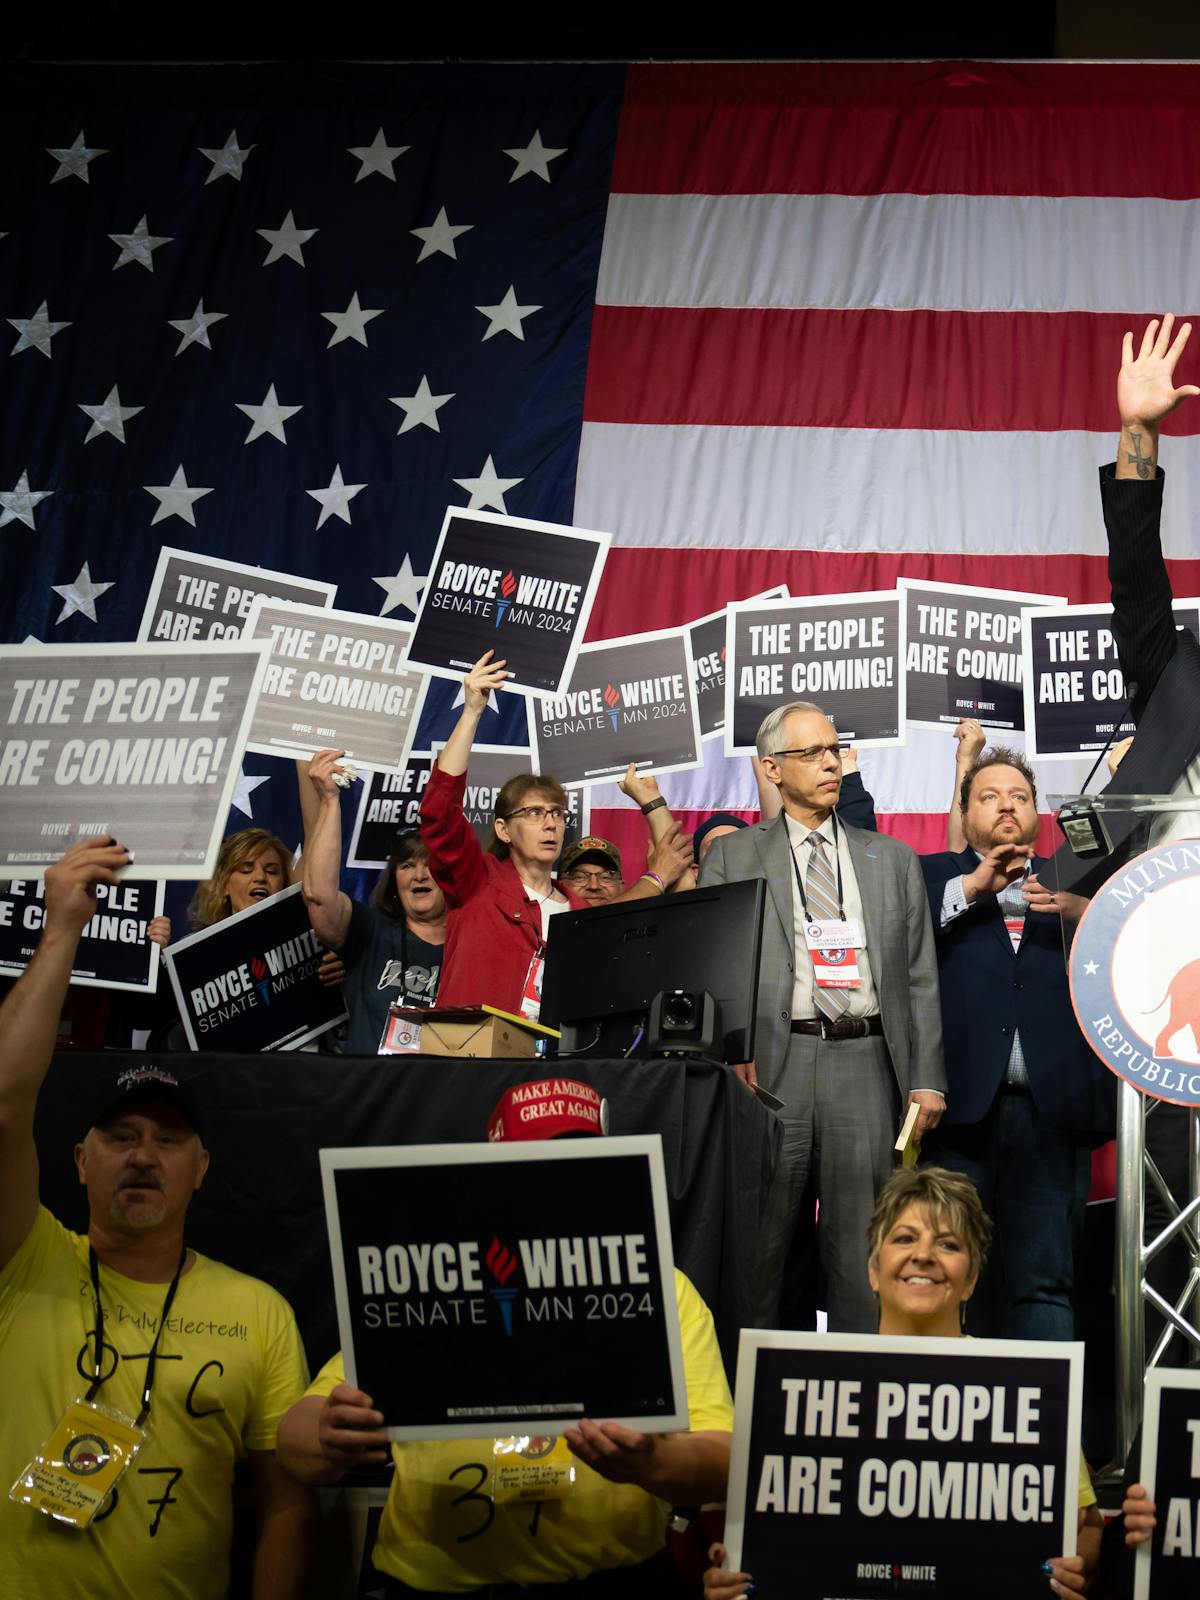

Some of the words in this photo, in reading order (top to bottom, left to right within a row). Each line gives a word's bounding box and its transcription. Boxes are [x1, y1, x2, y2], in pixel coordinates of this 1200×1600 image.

[175, 574, 219, 611] THE
[437, 560, 503, 599] ROYCE
[515, 574, 582, 615] WHITE
[155, 610, 201, 641] ARE
[431, 592, 493, 618] SENATE
[508, 608, 534, 626] MN
[536, 613, 572, 634] 2024
[917, 604, 957, 638] THE
[965, 610, 1021, 644] PEOP
[271, 625, 315, 660] THE
[749, 624, 791, 655] THE
[799, 617, 885, 652] PEOPLE
[1046, 631, 1090, 662] THE
[739, 664, 784, 697] ARE
[791, 656, 894, 694] COMING!
[906, 642, 950, 676] ARE
[8, 679, 80, 724] THE
[83, 676, 230, 724] PEOPLE
[262, 664, 297, 698] RE
[300, 671, 413, 717] COMING!
[541, 688, 604, 722] ROYCE
[620, 674, 685, 708] WHITE
[956, 699, 974, 709] ROYCE
[978, 702, 995, 711] WHITE
[1039, 672, 1084, 704] ARE
[543, 715, 606, 738] SENATE
[624, 709, 648, 724] MN
[652, 702, 687, 720] 2024
[1095, 723, 1114, 733] ROYCE
[1119, 723, 1137, 732] WHIT
[0, 740, 50, 786] RE
[54, 737, 228, 786] COMING!
[41, 823, 71, 836] ROYCE
[78, 823, 109, 836] WHITE
[366, 800, 402, 823] ARE
[23, 905, 147, 945] CING!
[21, 948, 35, 956] ROY
[190, 963, 253, 1016] ROYCE
[264, 928, 324, 977] WHITE
[199, 992, 258, 1033] SENATE
[272, 974, 295, 994] MN
[299, 959, 320, 981] 202
[512, 1082, 551, 1105] MAKE
[552, 1080, 600, 1105] AMERICA
[520, 1100, 565, 1122] GREAT
[567, 1101, 598, 1123] AGAIN
[358, 1242, 484, 1295] ROYCE
[518, 1234, 650, 1289] WHITE
[364, 1298, 487, 1328] SENATE
[525, 1297, 574, 1322] MN
[584, 1293, 655, 1320] 2024
[781, 1378, 861, 1438] THE
[875, 1382, 1041, 1444] PEOPLE
[755, 1455, 843, 1515] ARE
[857, 1458, 1055, 1523] COMING!
[857, 1563, 892, 1579] ROYCE
[901, 1565, 937, 1581] WHITE
